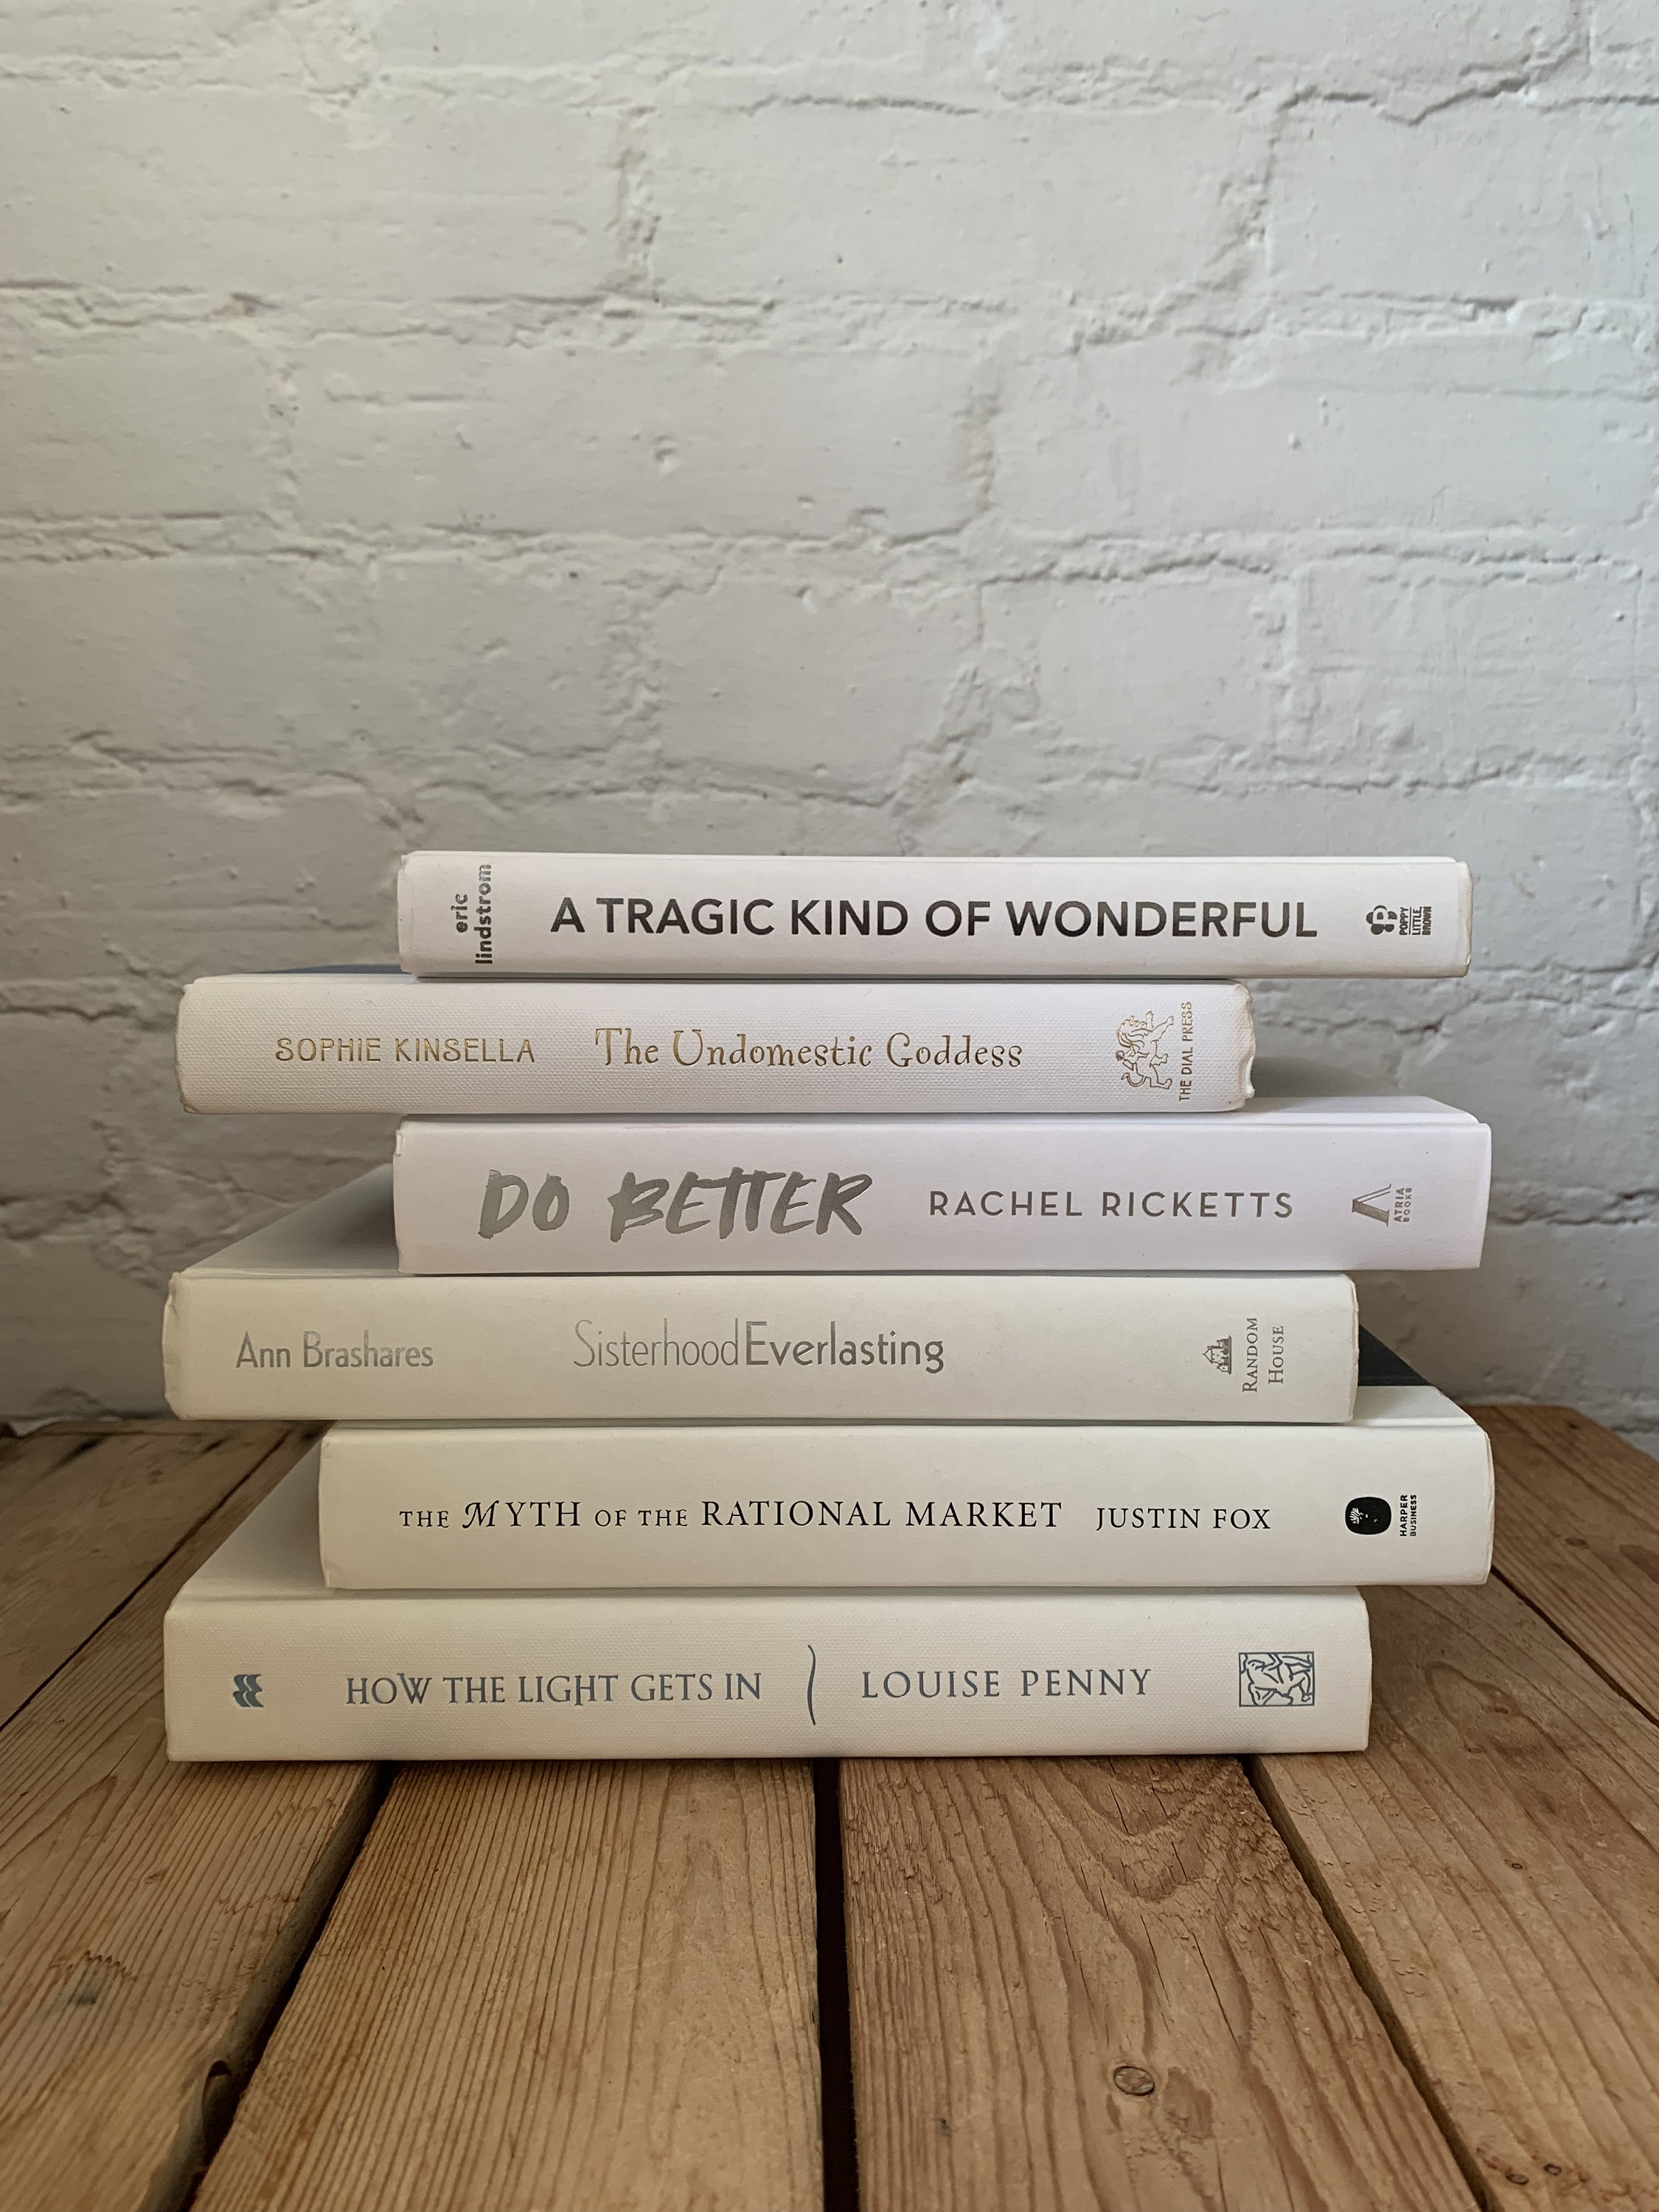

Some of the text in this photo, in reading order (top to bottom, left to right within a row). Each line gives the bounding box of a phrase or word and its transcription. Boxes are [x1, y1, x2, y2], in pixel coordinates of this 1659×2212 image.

[451, 864, 493, 964] eric lindstrom
[551, 897, 1317, 937] A TRAGIC KIND OF WONDERFUL
[1399, 906, 1409, 936] POPPY
[1422, 906, 1432, 936] BROWN
[276, 1038, 535, 1062] SOPHIE KINSELLA
[596, 1028, 1022, 1067] The Undomestic Goddess
[1179, 1002, 1193, 1101] THE DIAL PRESS
[478, 1167, 872, 1242] DO BETTER
[931, 1191, 1292, 1217] RACHEL RICKETTS
[1394, 1188, 1405, 1222] ATRIA
[1403, 1187, 1413, 1222] BOOKS
[236, 1331, 433, 1368] Ann Brashares
[1242, 1318, 1257, 1392] RANDOM
[1268, 1326, 1284, 1384] HOUSE
[400, 1500, 1061, 1528] THE MYTH OF THE RATIONAL MARKET
[1096, 1508, 1270, 1531] JUSTIN FOX
[1399, 1495, 1408, 1537] HARPER
[347, 1673, 761, 1706] HOW THE LIGHT GETS IN
[862, 1669, 1151, 1698] LOUISE PENNY
